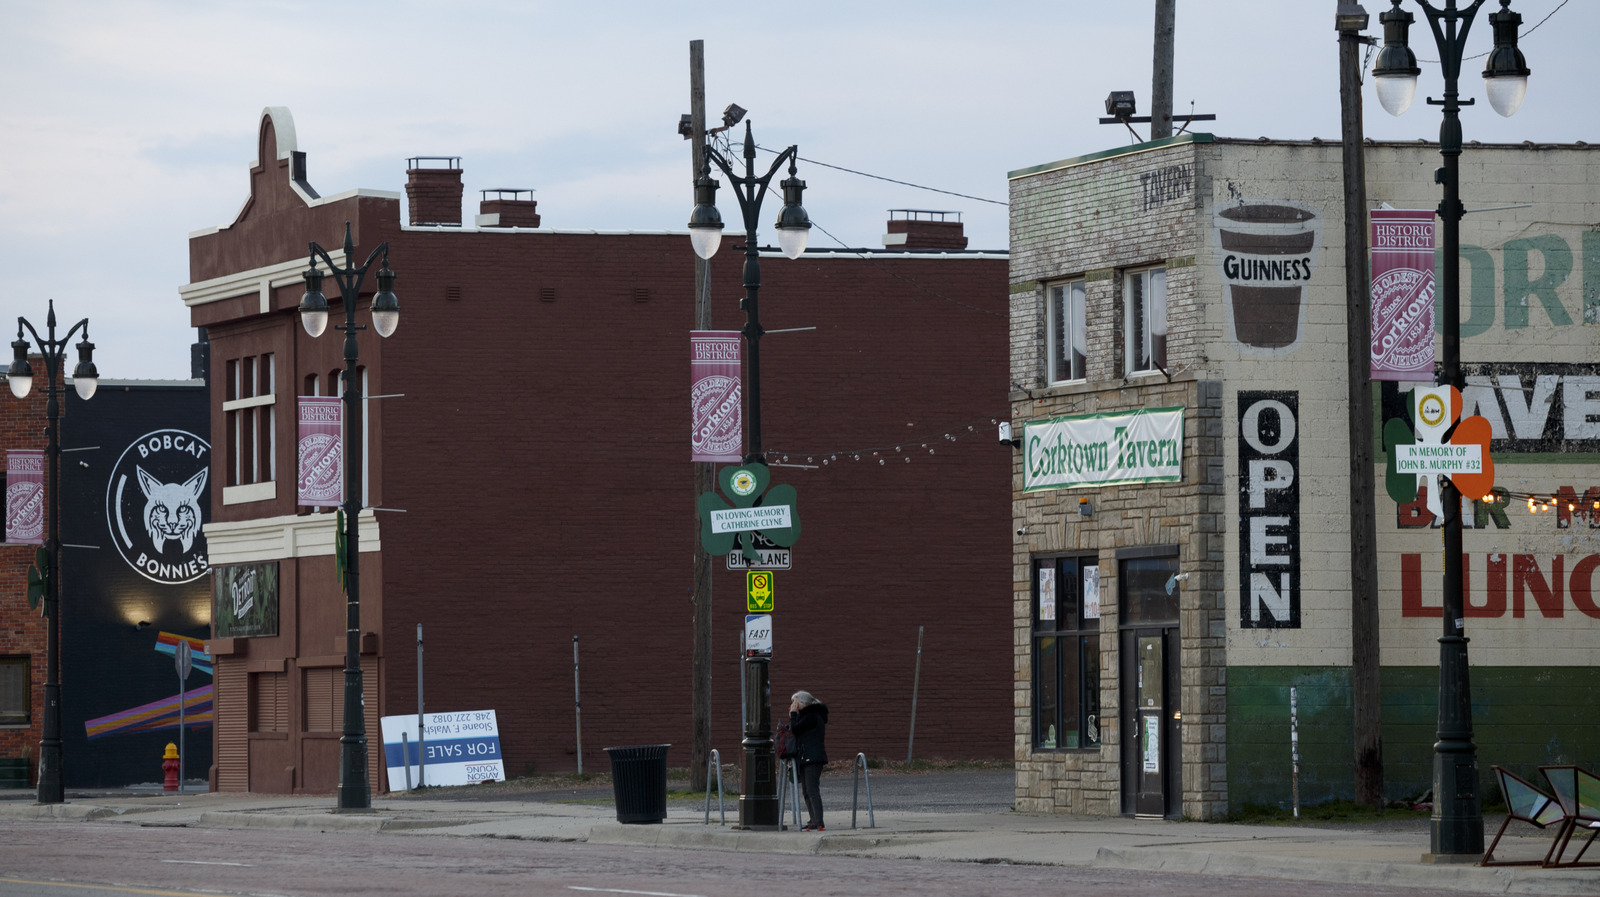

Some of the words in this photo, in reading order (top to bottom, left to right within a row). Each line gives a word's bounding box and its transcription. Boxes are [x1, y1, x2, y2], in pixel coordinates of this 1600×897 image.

[1376, 225, 1432, 236] HISTORIC
[1377, 236, 1432, 247] DISTRICT
[1223, 254, 1311, 281] GUINNESS
[1381, 272, 1419, 289] OLDEST
[1380, 295, 1402, 318] Since
[1371, 280, 1435, 360] Corktown
[1406, 321, 1425, 343] 1834
[695, 342, 739, 351] HISTORIC
[695, 351, 739, 360] DISTRICT
[301, 406, 339, 414] HISTORIC
[699, 396, 716, 414] Since
[301, 413, 339, 421] DISTRICT
[692, 385, 741, 446] Corktown
[720, 416, 735, 433] 1834
[137, 435, 207, 459] BOBCAT
[1028, 432, 1109, 478] Corktown
[1114, 426, 1180, 470] Tavern
[1408, 447, 1419, 457] IN
[1419, 447, 1454, 457] MEMORY
[1456, 447, 1467, 457] OF
[299, 441, 341, 492] Corktown
[1398, 460, 1419, 471] JOHN
[1420, 460, 1428, 470] B.
[1429, 460, 1464, 470] MURPHY
[1465, 459, 1481, 470] #32
[715, 513, 724, 521] IN
[724, 511, 752, 520] LOVING
[753, 508, 786, 518] MEMORY
[1242, 399, 1296, 621] OPEN
[721, 519, 760, 530] CATHERINE
[761, 518, 783, 526] CLYNE
[760, 553, 789, 565] LANE
[136, 552, 208, 579] BONNIE'S
[748, 629, 770, 639] FAST
[432, 714, 453, 723] 0182
[423, 725, 452, 736] Walsh
[462, 722, 493, 732] Sloane
[426, 744, 462, 758] SALE
[467, 742, 496, 755] FOR
[466, 764, 498, 773] YOUNG
[467, 771, 499, 780] AVISON
